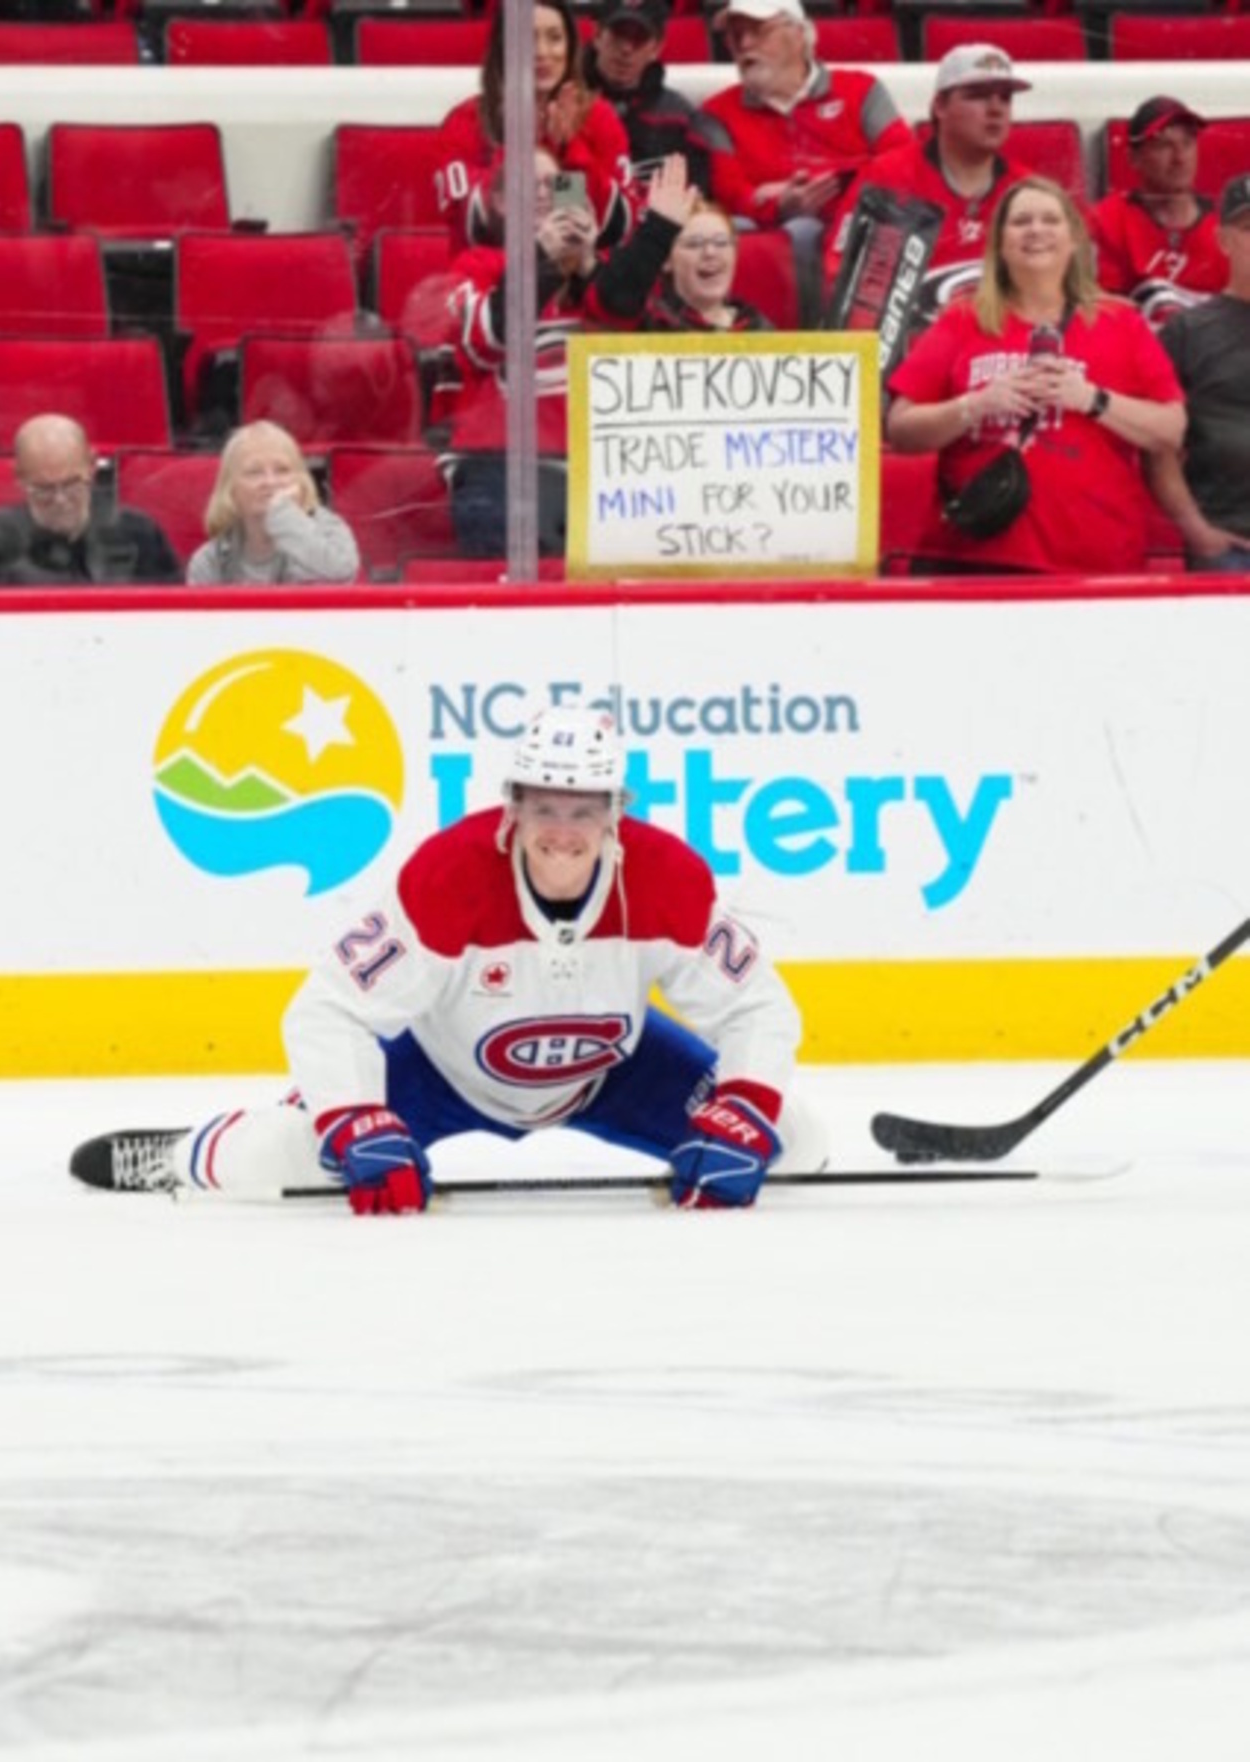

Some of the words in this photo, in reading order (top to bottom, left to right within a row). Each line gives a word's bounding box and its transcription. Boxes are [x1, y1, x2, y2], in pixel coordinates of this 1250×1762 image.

[591, 356, 855, 415] SLAFKOVSKY
[593, 432, 707, 477] TRADE
[724, 429, 859, 470] MYSTERY
[598, 486, 674, 522] MINI
[702, 483, 754, 515] FOR
[772, 480, 854, 515] YOUR
[429, 683, 527, 740] NC
[334, 911, 407, 992] 21
[703, 918, 758, 985] 2
